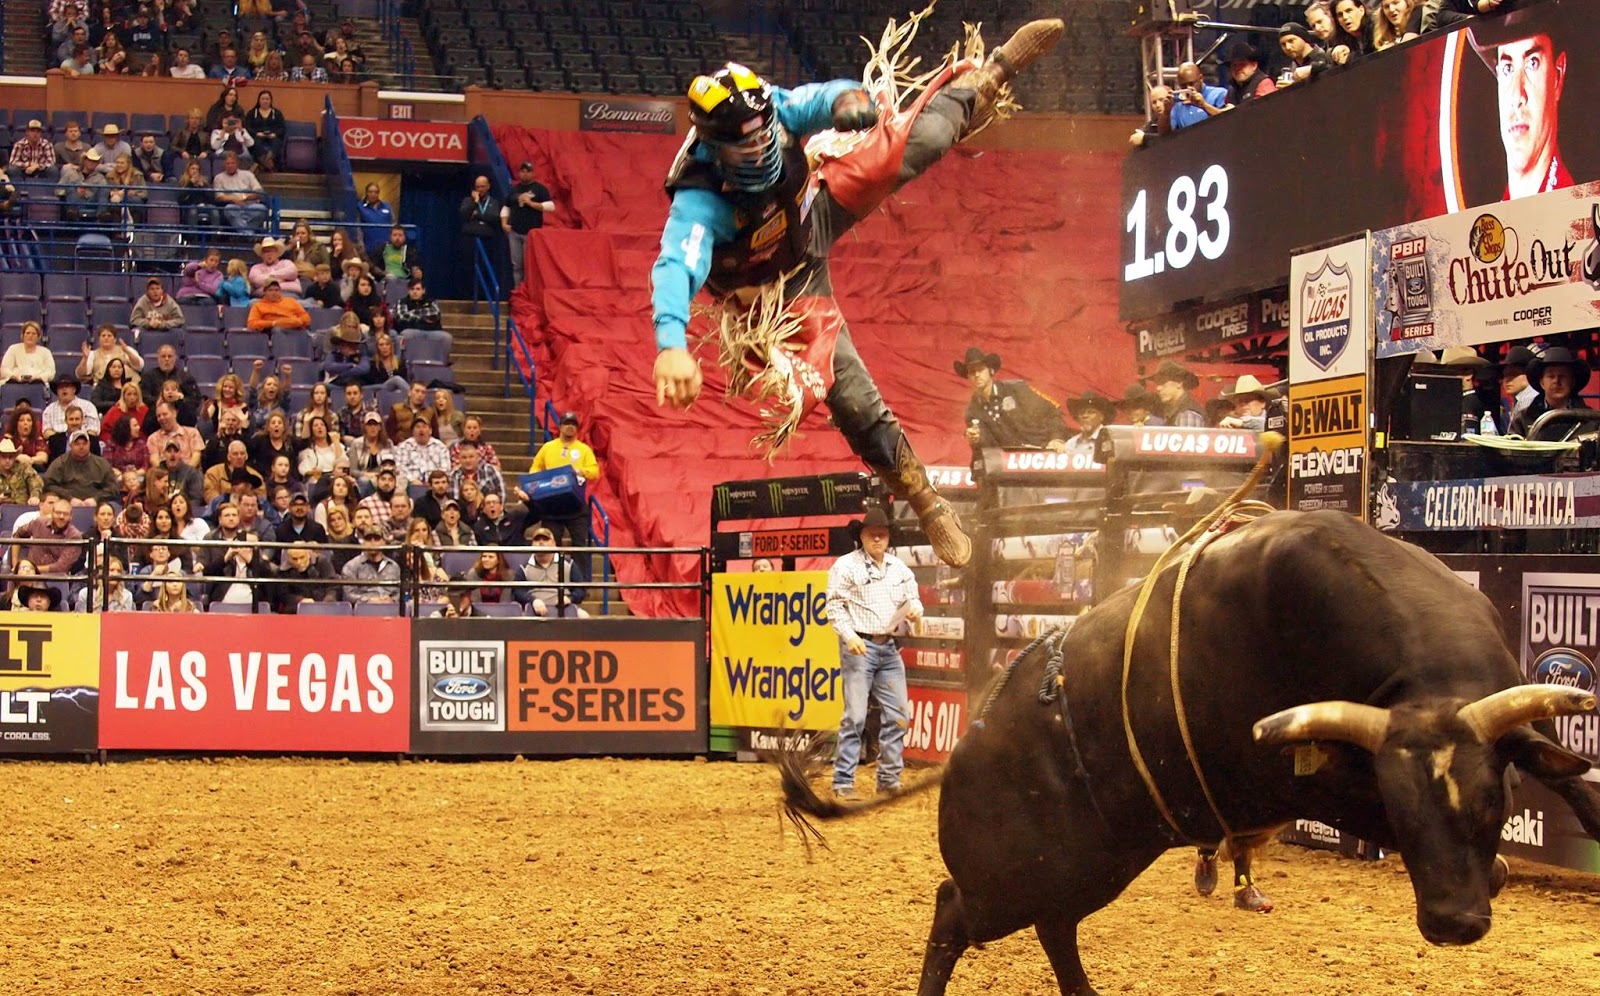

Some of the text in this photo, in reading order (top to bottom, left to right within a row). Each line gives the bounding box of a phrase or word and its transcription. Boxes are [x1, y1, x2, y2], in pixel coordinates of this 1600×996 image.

[392, 105, 412, 118] EXIT
[584, 102, 672, 122] Bommarito
[378, 131, 462, 149] TOYOTA
[1125, 164, 1230, 281] 1.83
[1391, 238, 1425, 258] PBR
[1405, 263, 1424, 279] BUILT
[1449, 236, 1576, 305] Chute Out
[1307, 293, 1347, 324] LUCAS
[1407, 296, 1428, 308] TOUGH
[1196, 303, 1248, 331] COOPER
[1513, 306, 1552, 321] COOPER
[1532, 318, 1552, 327] TIRES
[1220, 321, 1248, 338] TIRES
[1304, 325, 1348, 343] OIL PRODUCTS
[1404, 324, 1432, 338] SERIES
[1319, 344, 1332, 356] INC.
[1141, 433, 1247, 454] LUCAS OIL
[1007, 453, 1069, 470] LUCAS
[1424, 481, 1575, 527] CELEBRATE AMERICA
[755, 536, 779, 552] FORD
[781, 534, 826, 550] F-SERIES
[725, 583, 829, 646] Wrangle
[1531, 594, 1600, 646] BUILT
[429, 651, 495, 675] BUILT
[518, 650, 618, 684] FORD
[115, 650, 207, 711] LAS
[228, 652, 394, 714] VEGAS
[445, 679, 477, 694] Ford
[724, 657, 841, 721] Wrangler
[429, 702, 495, 720] TOUGH
[519, 688, 685, 722] F-SERIES
[903, 700, 960, 752] CAS OIL
[1555, 714, 1600, 755] UGH
